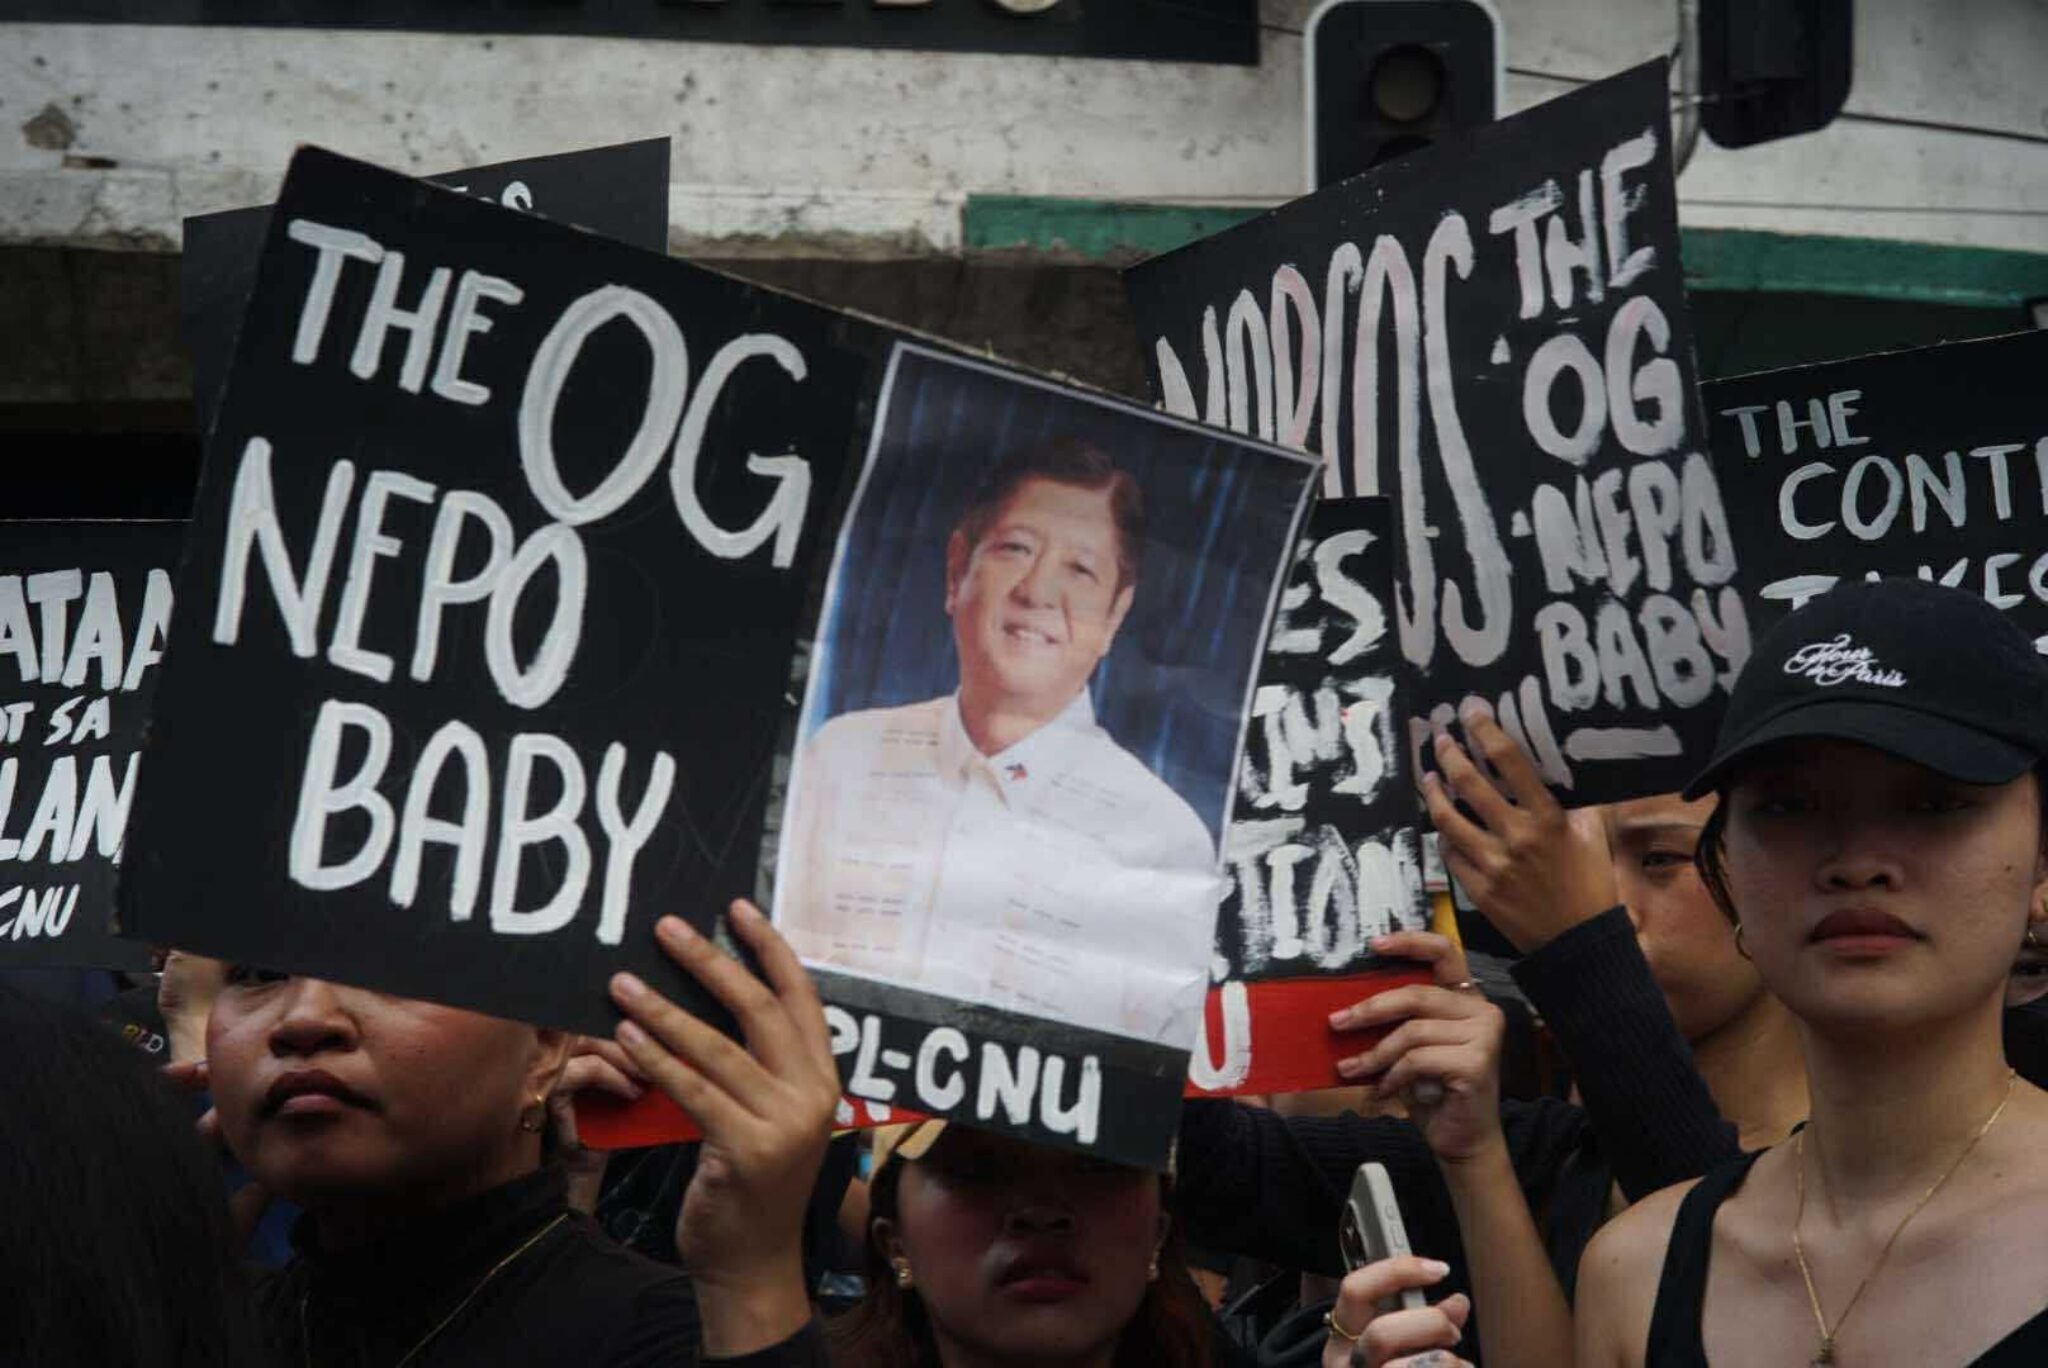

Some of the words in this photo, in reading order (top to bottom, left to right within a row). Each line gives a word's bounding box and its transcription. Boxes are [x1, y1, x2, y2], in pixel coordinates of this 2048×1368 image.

[1489, 128, 1658, 319] THE
[288, 218, 524, 405] THE
[518, 284, 811, 569] OG
[1523, 296, 1684, 466] OG
[1720, 389, 1872, 459] THE
[212, 436, 587, 709] NEPO
[1532, 453, 1738, 594] NEPO
[43, 695, 110, 746] SA
[1534, 586, 1753, 710] BABY
[288, 699, 676, 945] BABY
[1210, 816, 1428, 984] TION
